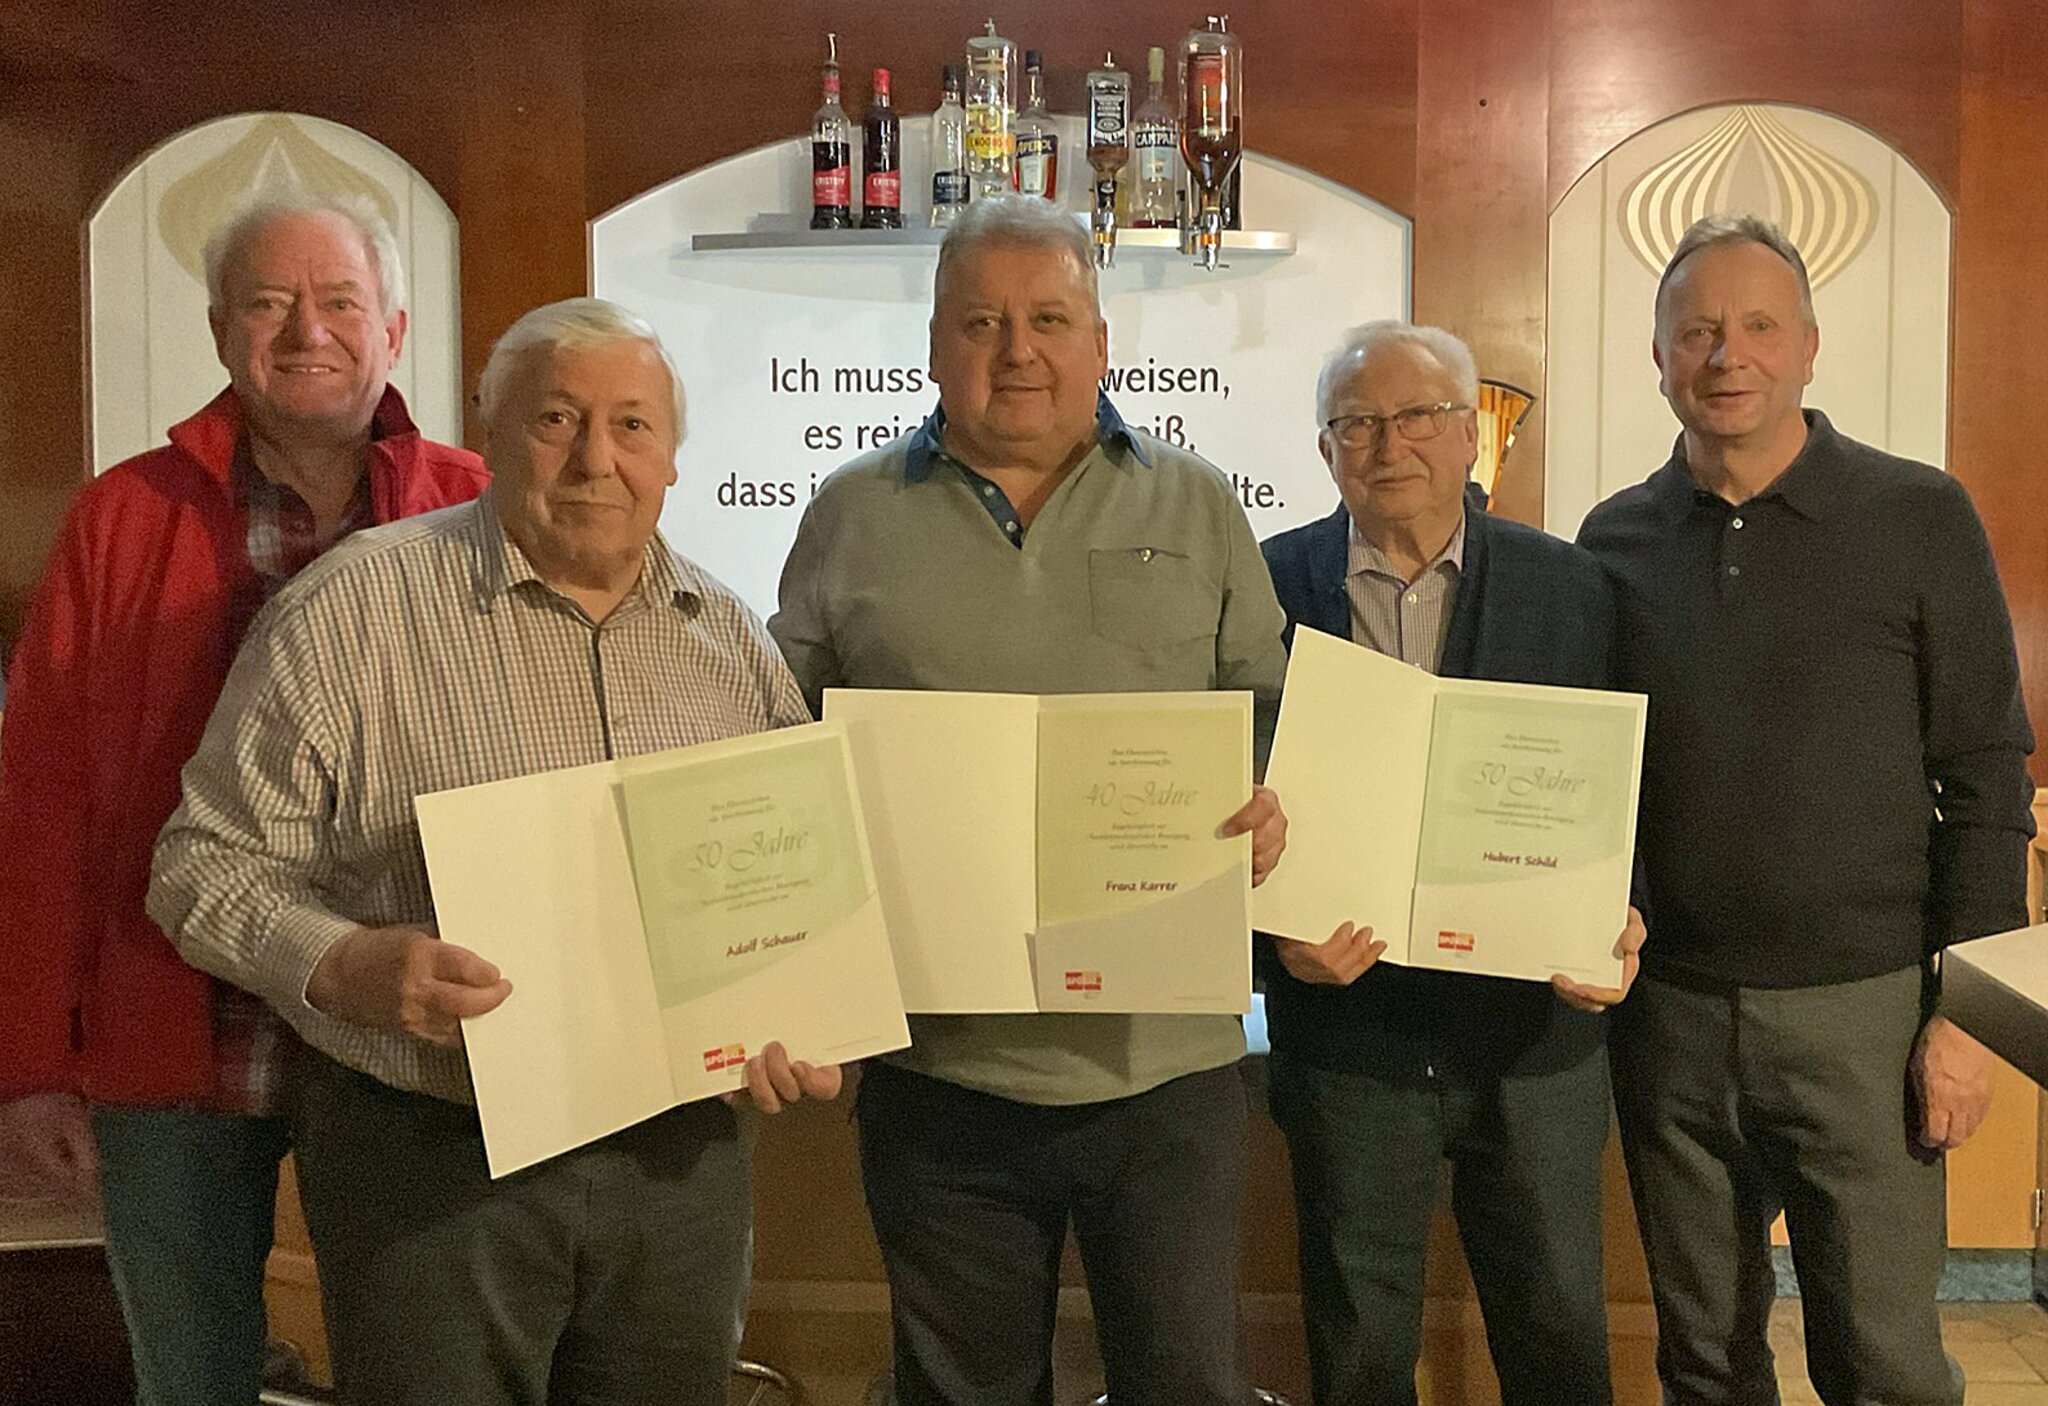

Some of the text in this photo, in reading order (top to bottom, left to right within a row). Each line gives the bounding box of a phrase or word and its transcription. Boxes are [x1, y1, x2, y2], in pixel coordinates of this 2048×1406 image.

[771, 357, 1230, 400] Ich muss weisen,
[804, 424, 843, 450] es
[717, 472, 796, 507] dass
[1474, 762, 1586, 796] 50 Jahre
[1083, 781, 1199, 816] 40 Jahre
[727, 826, 809, 872] Jahre
[1483, 852, 1558, 868] Hubert Schild
[1105, 880, 1178, 892] Franz Karrer
[726, 931, 808, 957] Adolf Schauer
